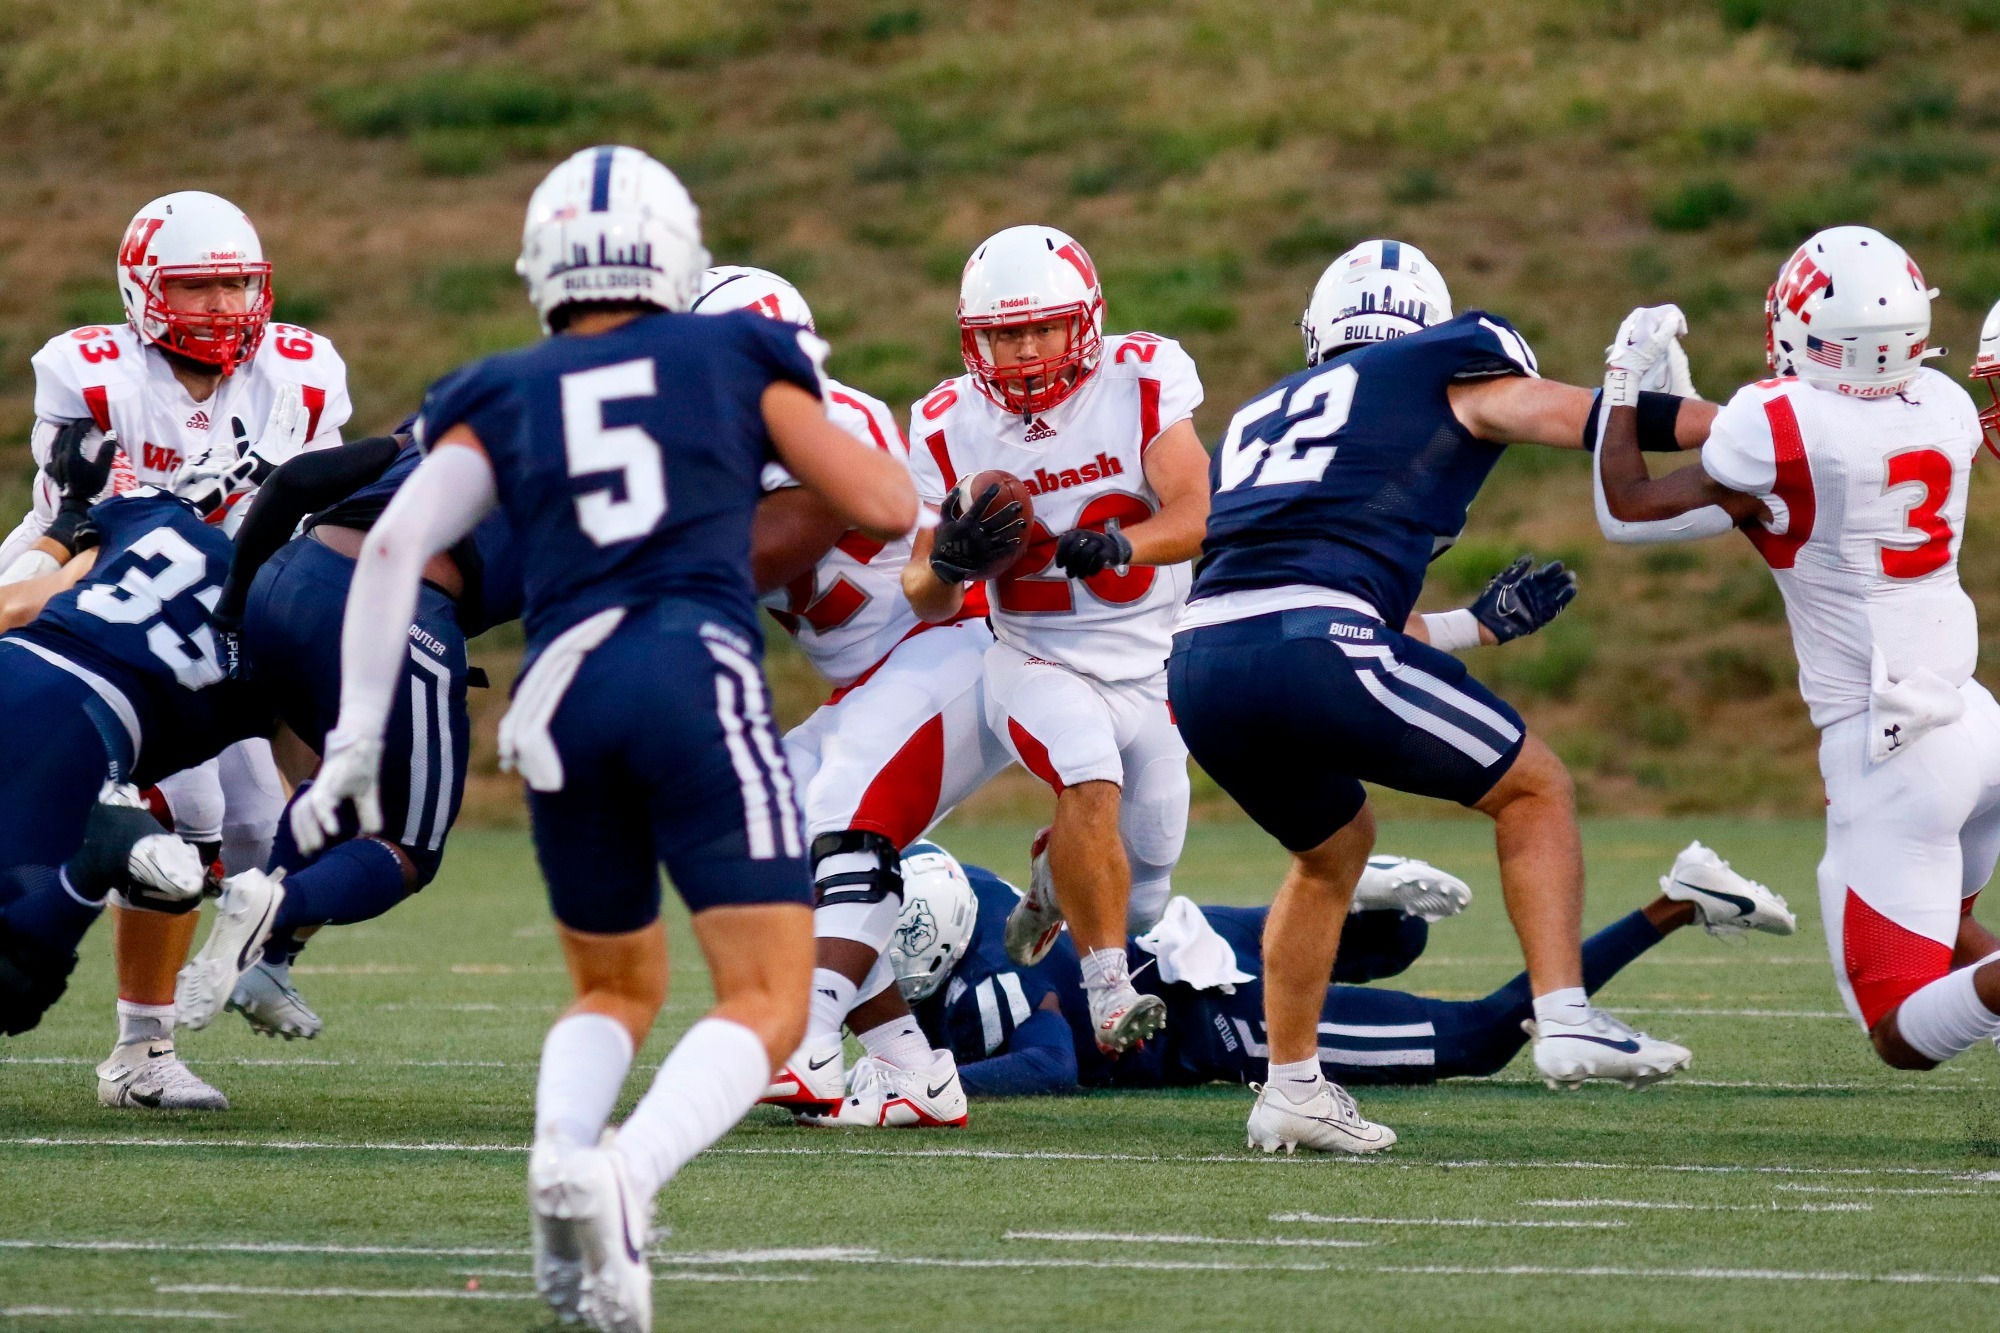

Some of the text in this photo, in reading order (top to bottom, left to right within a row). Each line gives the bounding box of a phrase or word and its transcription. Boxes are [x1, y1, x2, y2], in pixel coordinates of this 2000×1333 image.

[210, 251, 237, 261] Riddell
[1000, 297, 1030, 309] Riddell
[71, 325, 120, 365] 63
[275, 324, 315, 362] 63
[1344, 325, 1406, 341] BULLD
[922, 379, 959, 421] 0
[1838, 380, 1908, 396] Riddell
[1024, 429, 1057, 443] adidas
[1214, 362, 1360, 495] 52
[560, 357, 668, 549] 5
[1023, 451, 1124, 497] abash
[1874, 443, 1956, 584] 3
[408, 623, 447, 657] BUTLER
[1329, 622, 1374, 640] BUTLER
[1213, 1013, 1239, 1052] BUTLER
